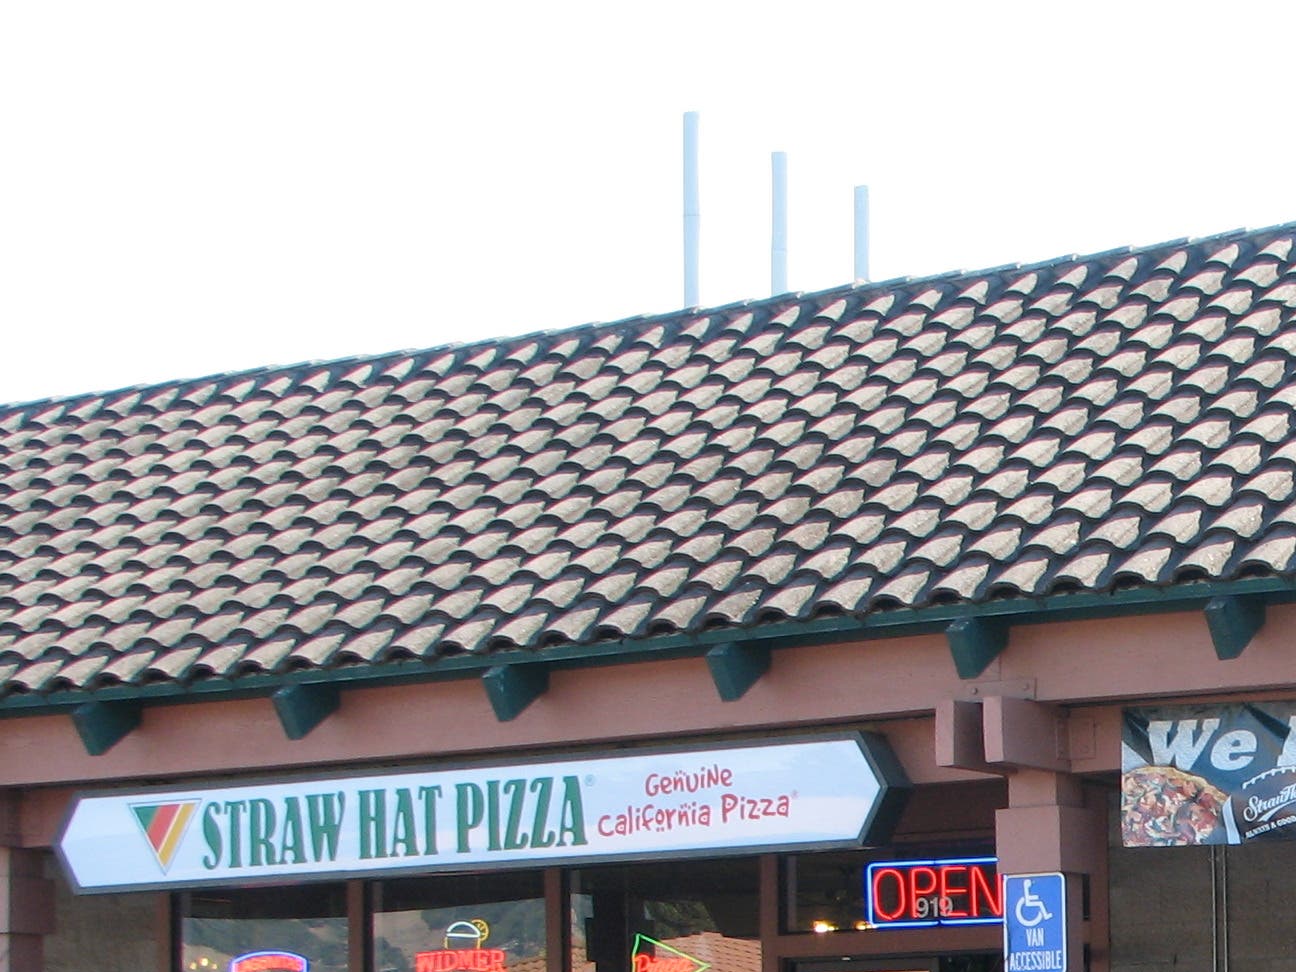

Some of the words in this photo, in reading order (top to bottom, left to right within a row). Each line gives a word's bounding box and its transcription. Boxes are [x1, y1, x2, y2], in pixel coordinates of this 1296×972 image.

[1148, 717, 1257, 771] We
[201, 790, 346, 870] STRAW
[358, 785, 443, 860] HAT
[454, 775, 588, 854] PIZZA
[721, 793, 789, 823] Pizza
[872, 866, 1004, 921] OPEN
[915, 897, 954, 919] 919
[1025, 928, 1044, 947] VAN
[1009, 950, 1062, 971] ACCESSIBLE
